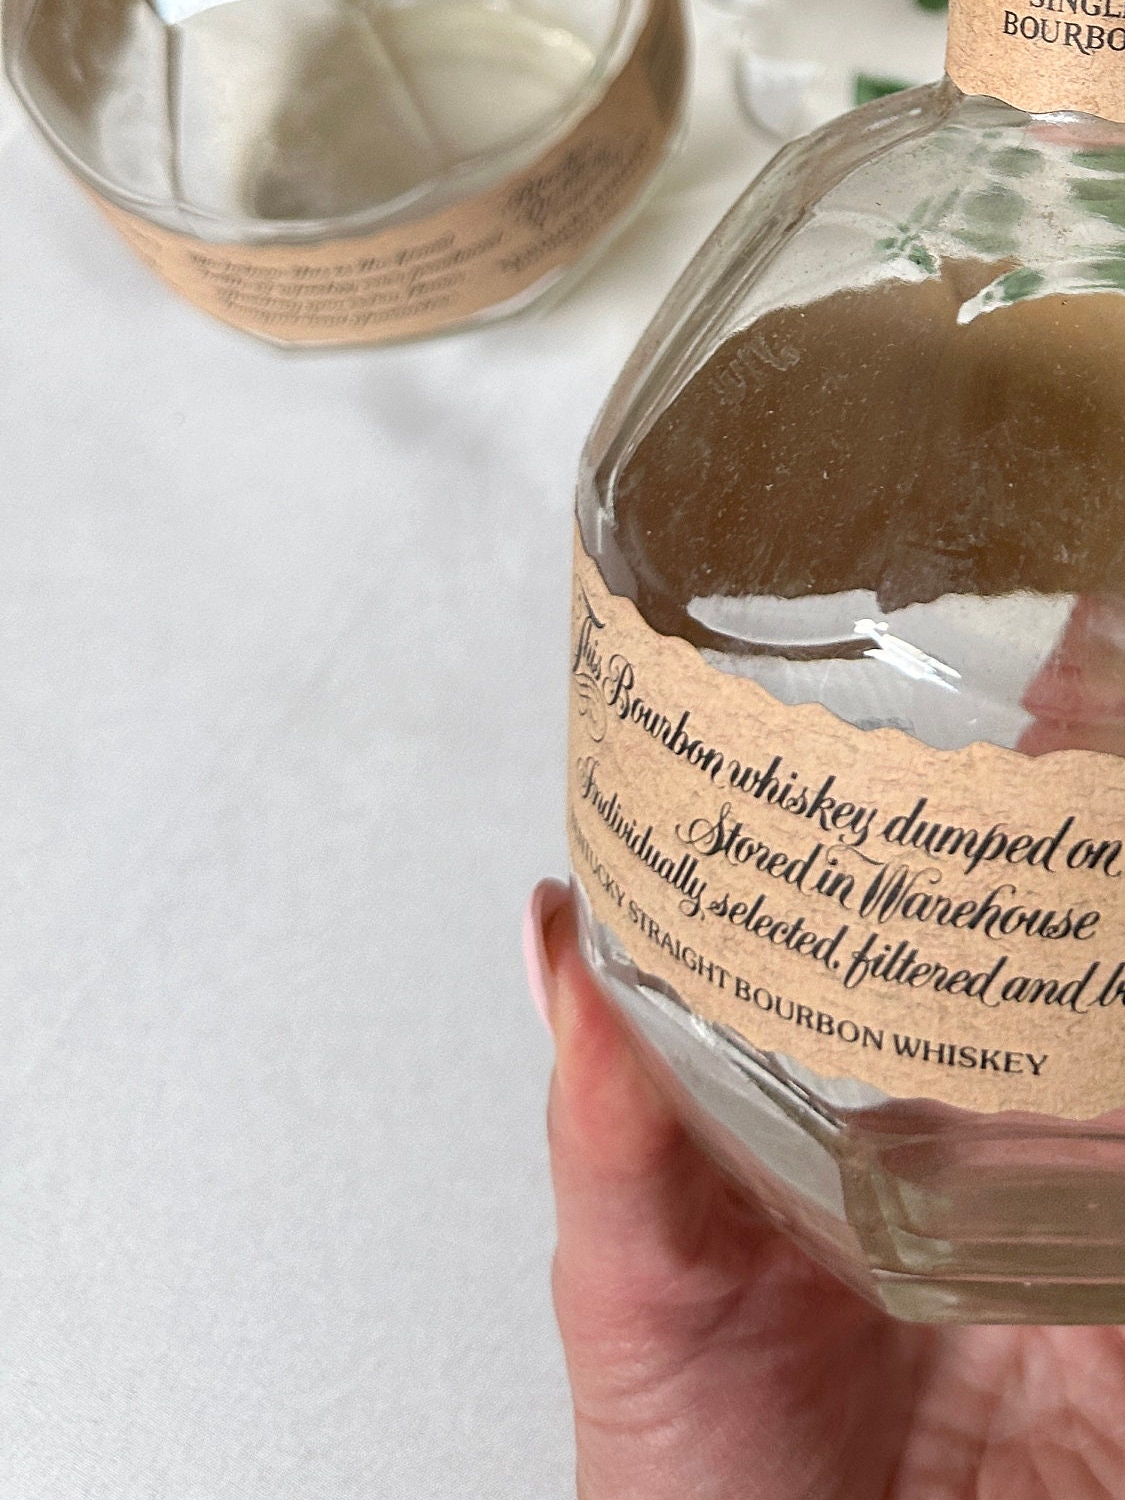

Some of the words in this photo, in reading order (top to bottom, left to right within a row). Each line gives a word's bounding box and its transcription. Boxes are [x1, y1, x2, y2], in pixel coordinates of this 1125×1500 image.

[602, 653, 726, 788] Bourbon
[727, 755, 878, 847] whiskey
[882, 797, 1076, 875] dumped
[1066, 834, 1121, 877] on
[674, 801, 826, 896] Stored
[813, 857, 857, 909] in
[825, 844, 1101, 941] Warehouse
[628, 899, 733, 988] STRAIGHT
[734, 976, 884, 1051] BOURBON
[891, 1033, 1049, 1077] WHISKEY
[843, 933, 1008, 1007] filtered
[1001, 956, 1100, 1014] and
